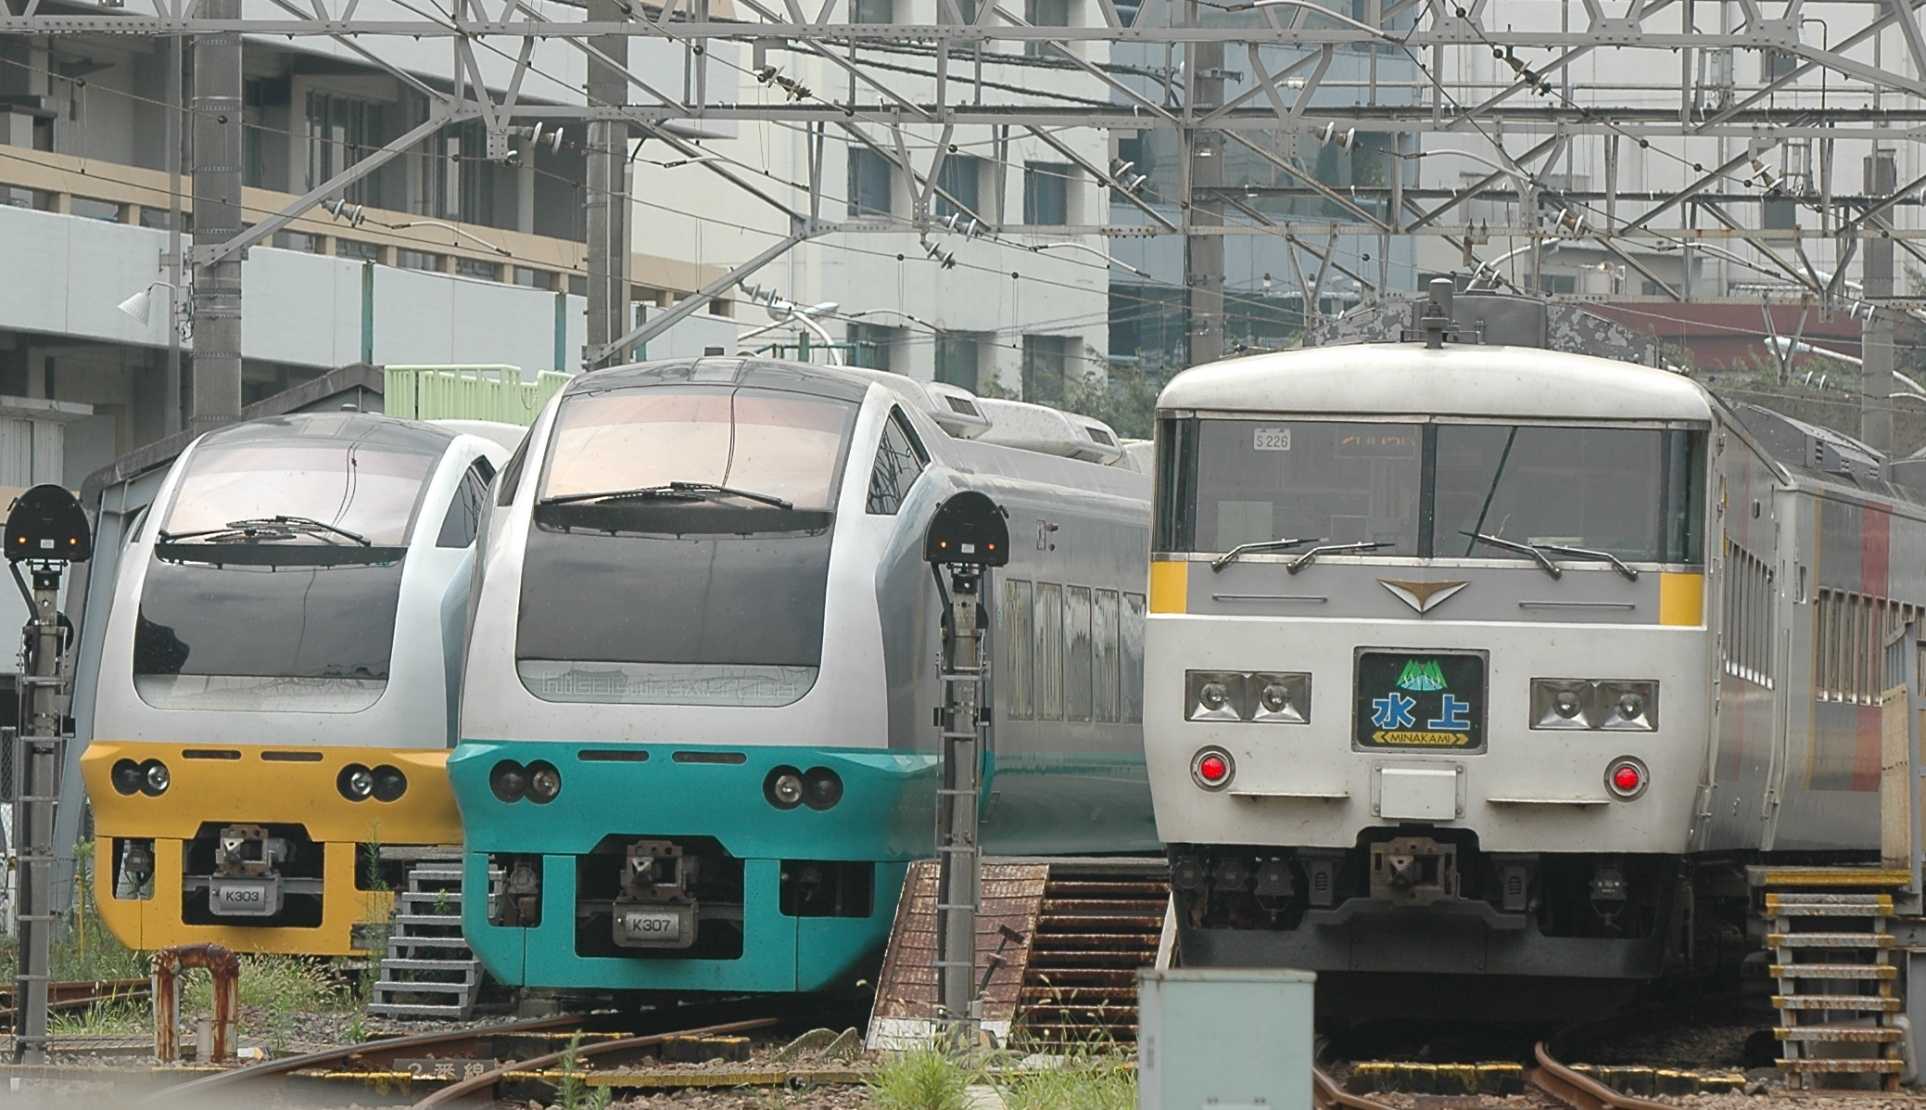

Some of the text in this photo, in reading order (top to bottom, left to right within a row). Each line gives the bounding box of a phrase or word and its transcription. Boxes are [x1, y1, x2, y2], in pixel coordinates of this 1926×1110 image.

[1371, 692, 1471, 730] 水上
[1390, 732, 1450, 743] MINAKAMI
[226, 891, 259, 902] K303
[632, 919, 672, 932] K307
